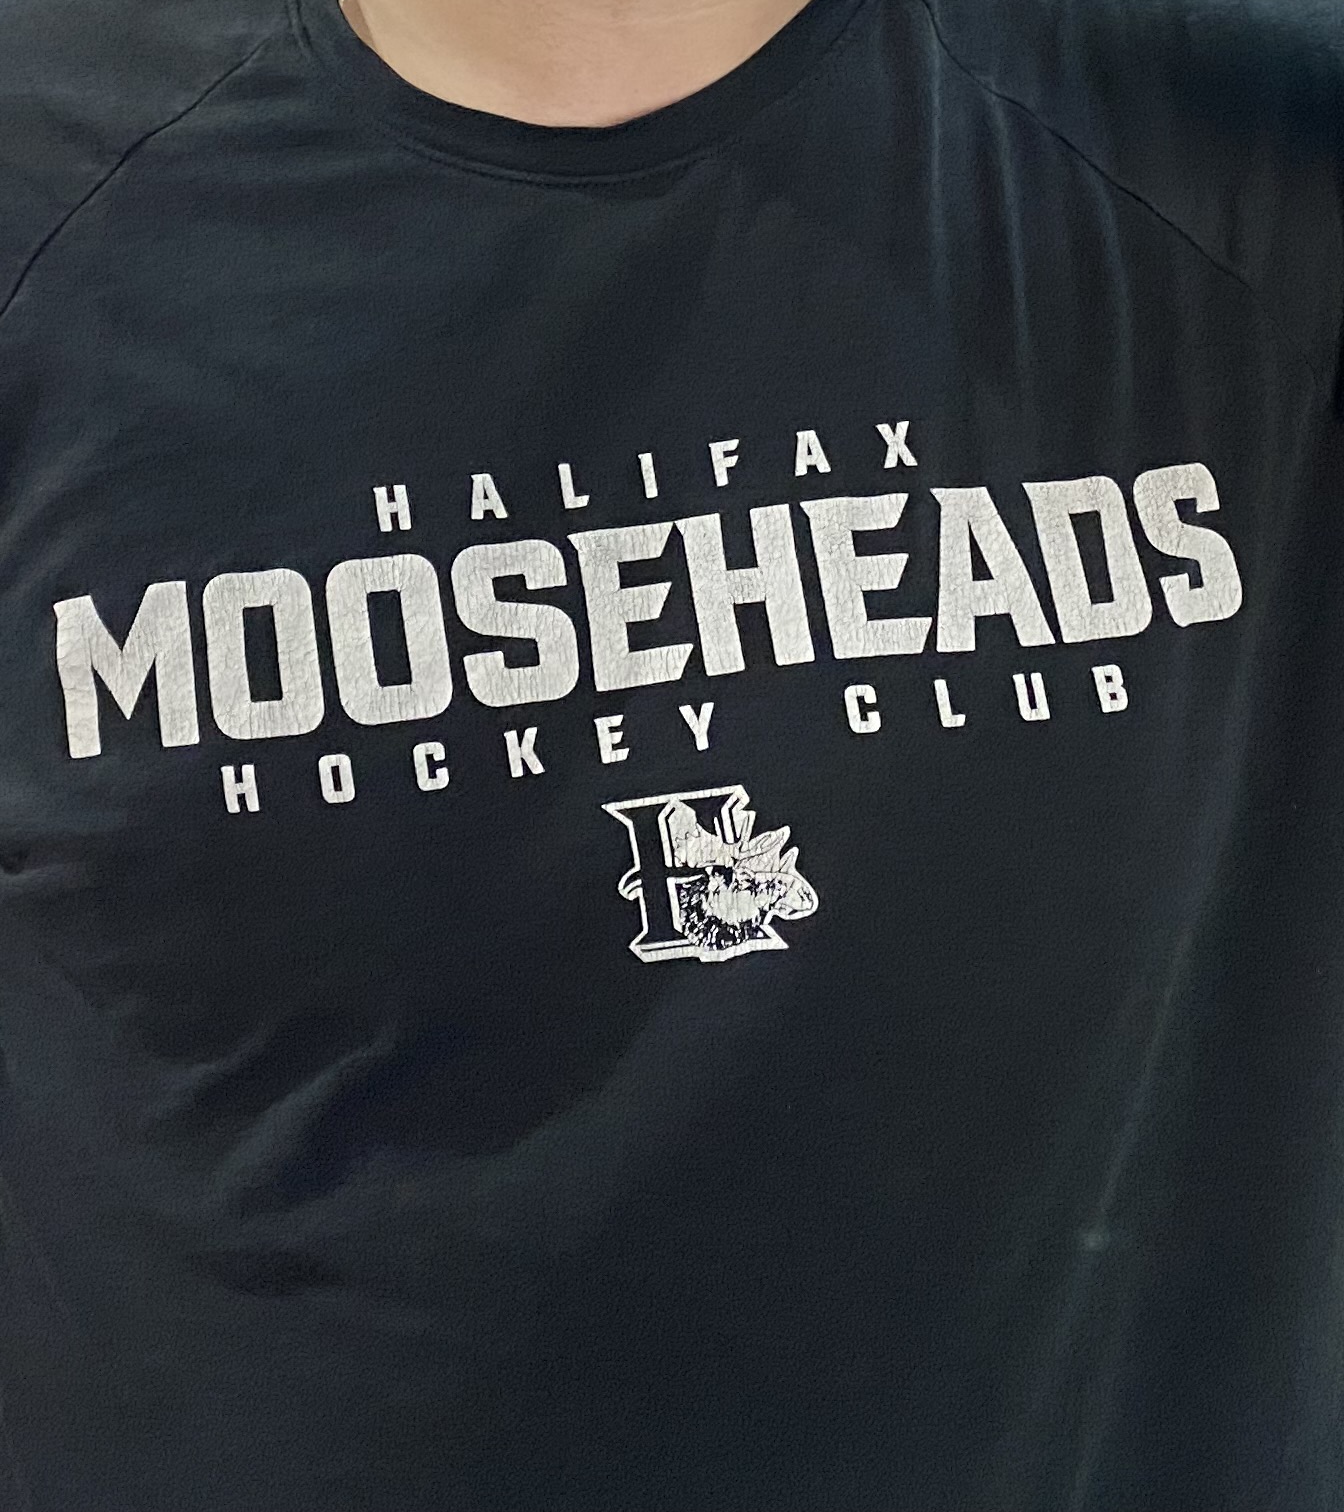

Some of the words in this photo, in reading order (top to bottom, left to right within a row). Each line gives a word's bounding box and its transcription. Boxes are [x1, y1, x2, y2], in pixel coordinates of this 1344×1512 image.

[372, 420, 918, 532] HALIFAX
[53, 461, 1245, 760] MOOSEHEADS
[220, 701, 716, 814] HOCKEY
[843, 664, 1131, 735] CLUB
